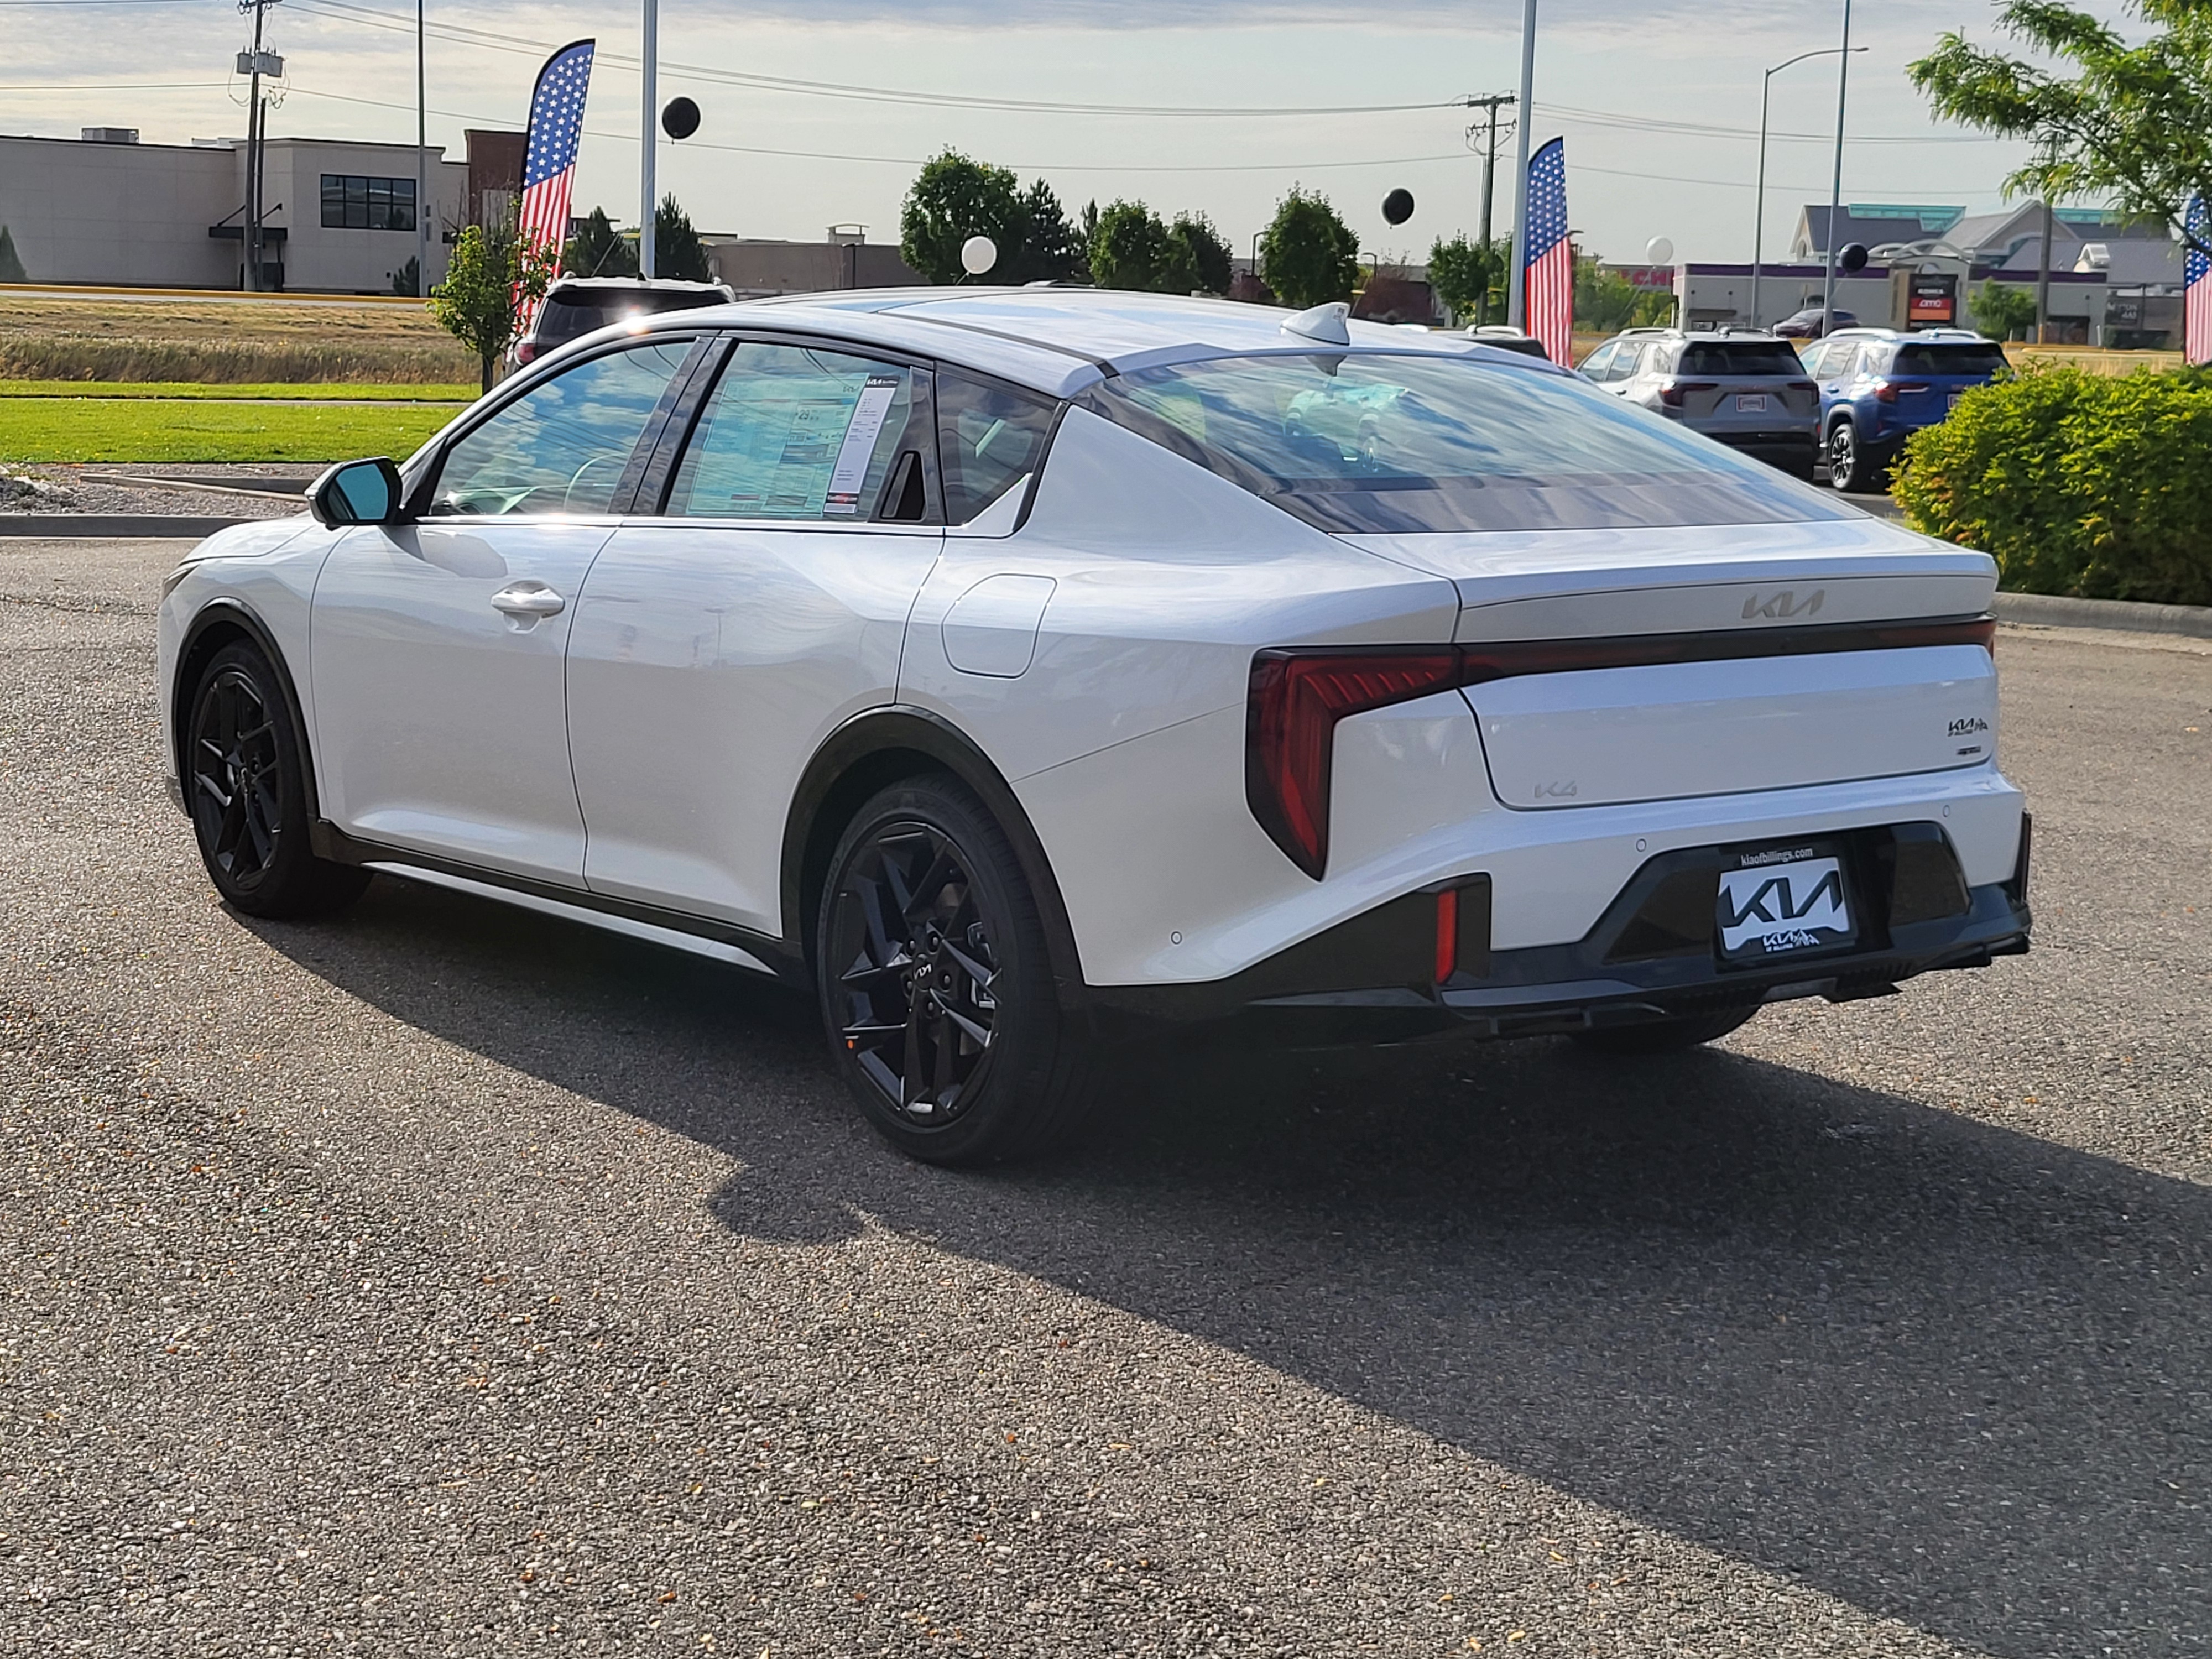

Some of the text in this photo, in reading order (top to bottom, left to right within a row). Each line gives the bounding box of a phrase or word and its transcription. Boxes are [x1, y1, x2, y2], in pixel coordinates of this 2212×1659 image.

[1741, 589, 1824, 619] KIA
[1948, 718, 1974, 731] KIA
[1534, 780, 1577, 798] K4
[1740, 848, 1813, 866] kiaofbillings.com
[1717, 870, 1843, 927] KIA
[1762, 931, 1793, 946] KIA
